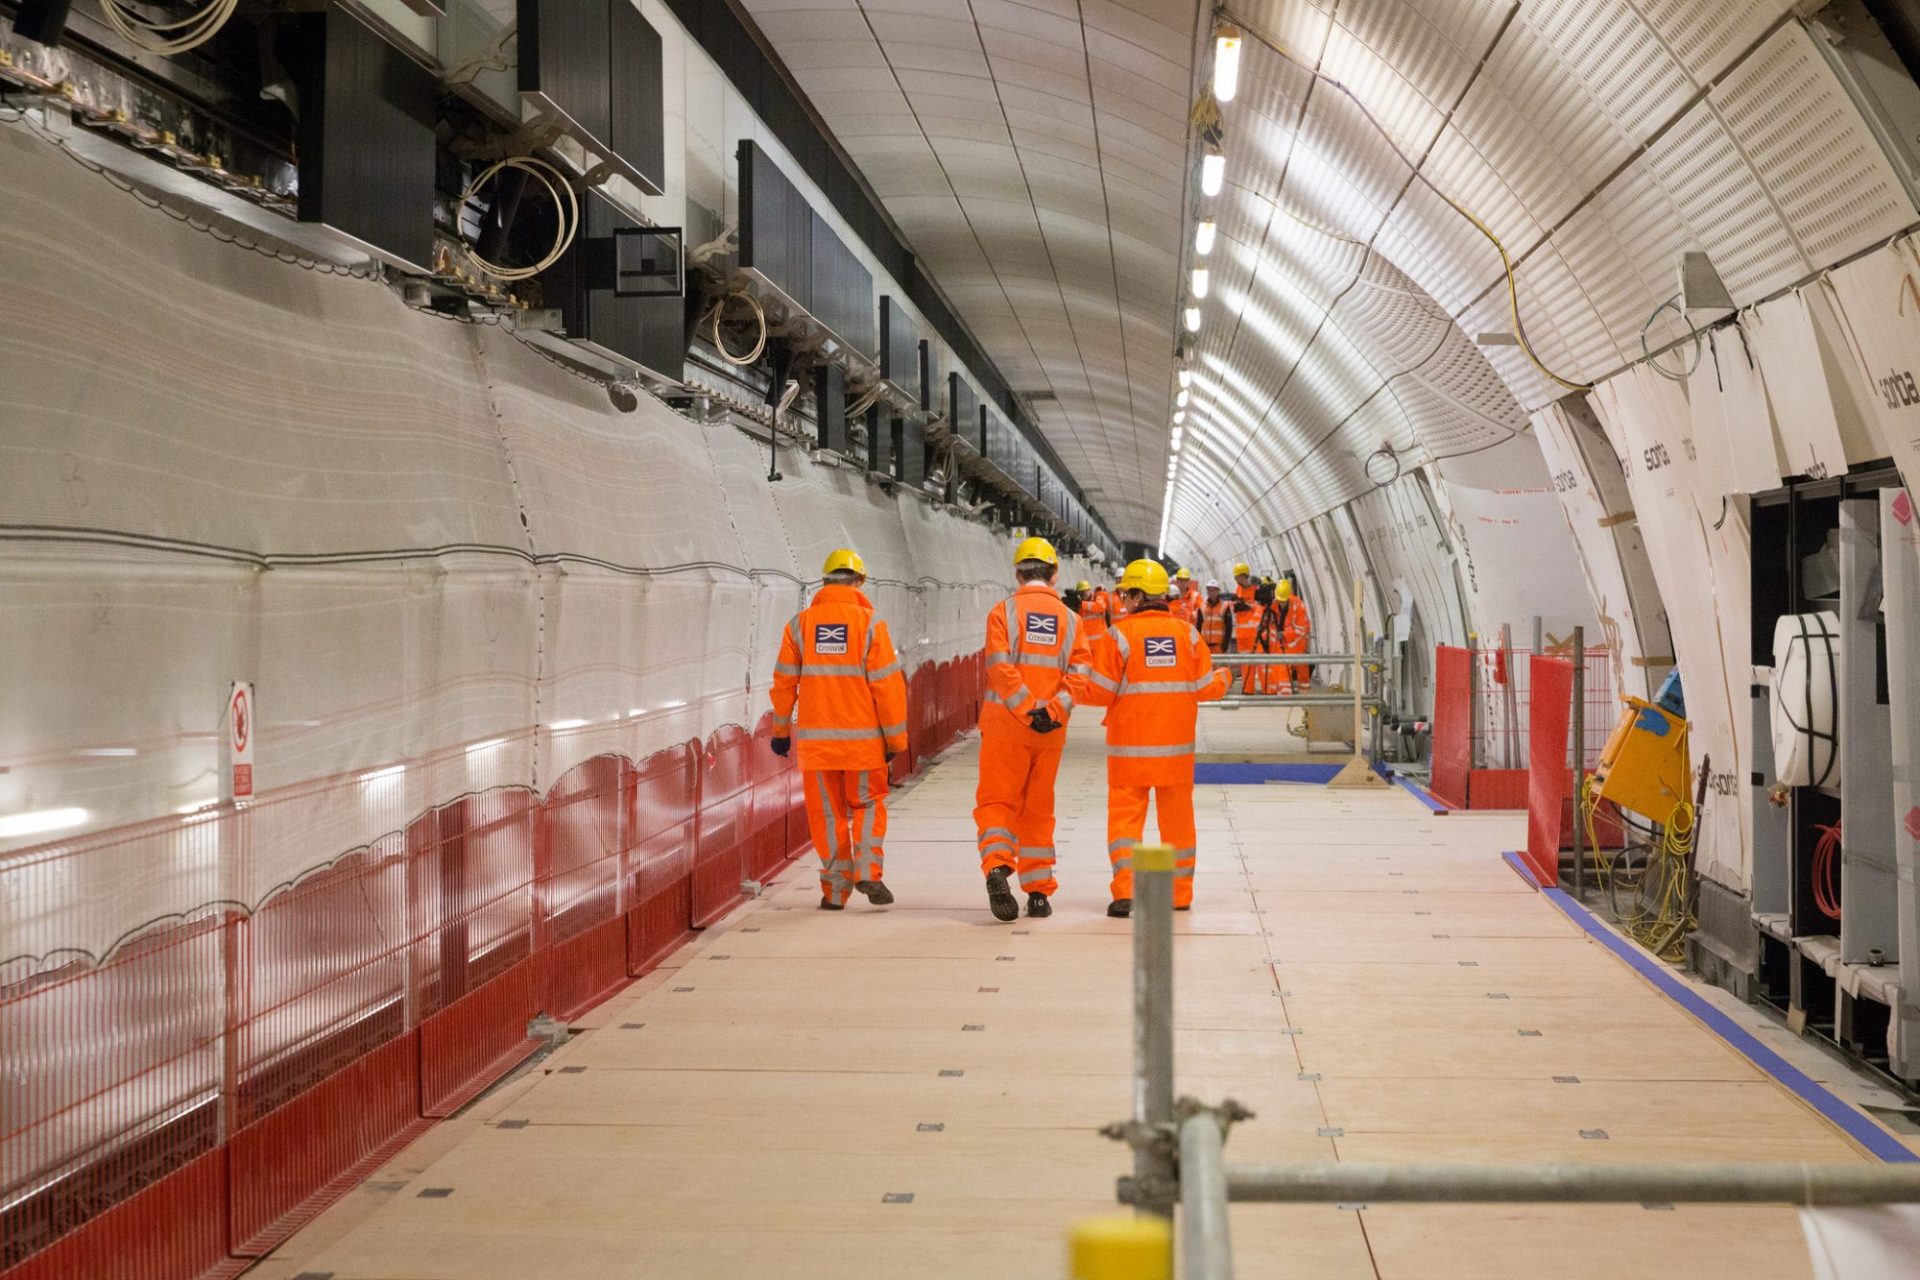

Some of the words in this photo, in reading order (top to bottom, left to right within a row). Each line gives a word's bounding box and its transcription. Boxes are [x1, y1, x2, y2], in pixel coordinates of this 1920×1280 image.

[1027, 633, 1054, 644] Crossrail
[817, 644, 845, 652] Crossrail
[1147, 656, 1174, 665] Crossrail
